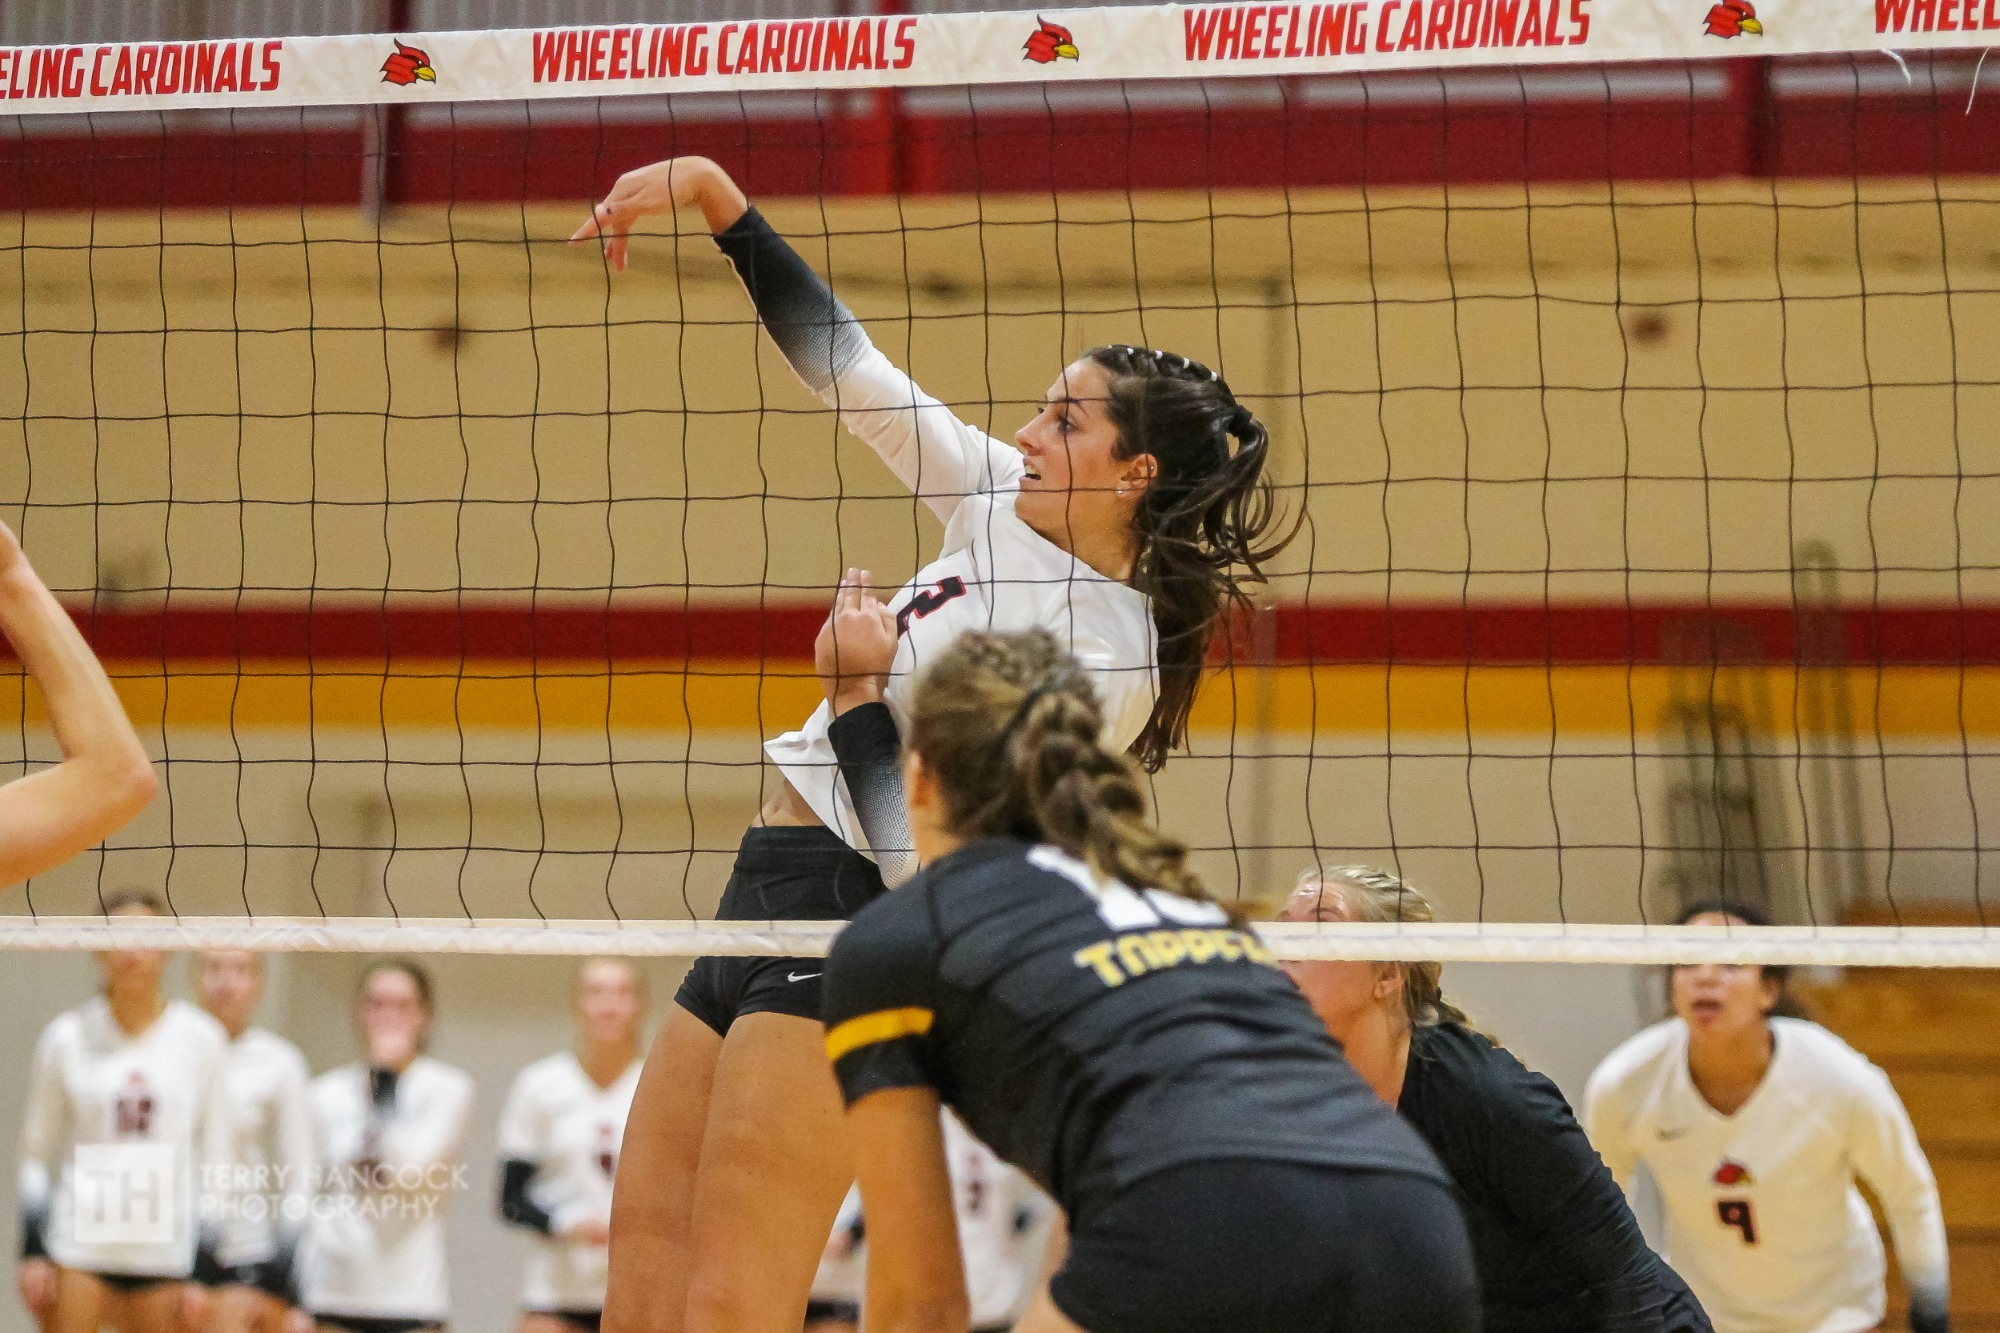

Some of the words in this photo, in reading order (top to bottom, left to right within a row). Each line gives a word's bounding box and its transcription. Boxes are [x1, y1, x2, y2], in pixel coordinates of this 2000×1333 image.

[533, 24, 709, 83] WHEELING
[717, 18, 917, 75] CARDINALS
[1184, 2, 1368, 61] WHEELING
[1375, 0, 1590, 53] CARDINALS
[89, 40, 283, 97] CARDINALS
[1716, 1199, 1758, 1244] 9
